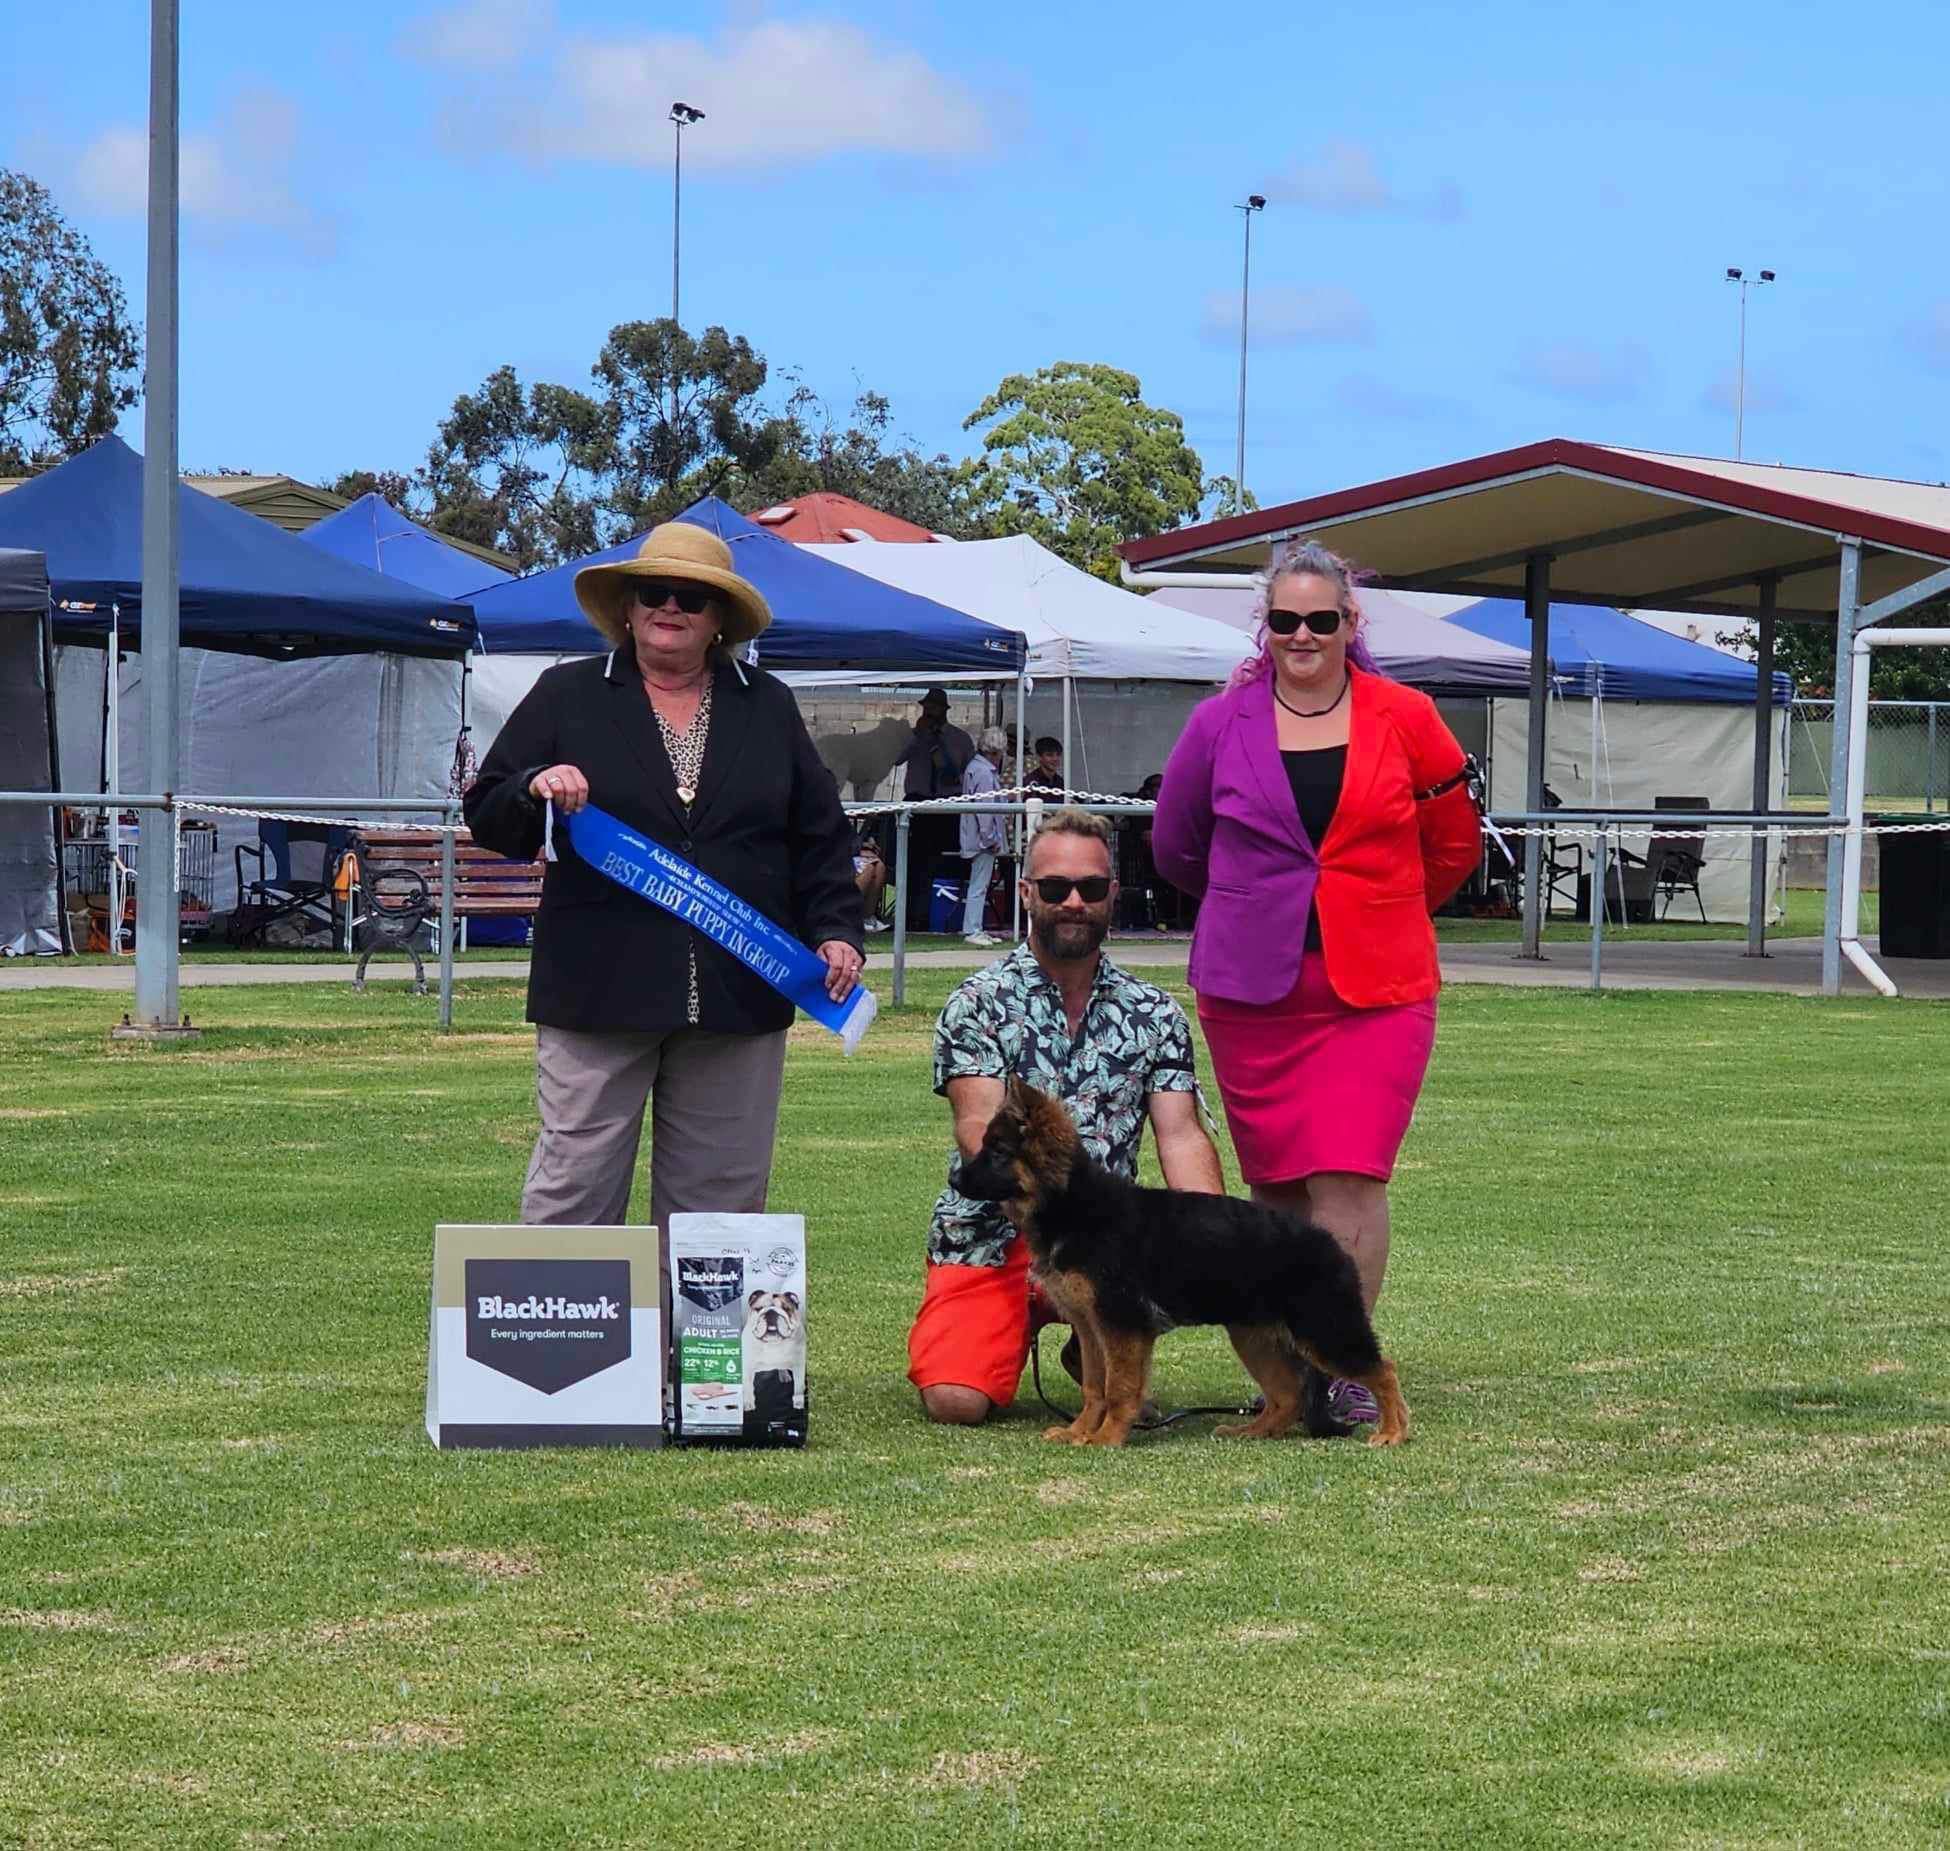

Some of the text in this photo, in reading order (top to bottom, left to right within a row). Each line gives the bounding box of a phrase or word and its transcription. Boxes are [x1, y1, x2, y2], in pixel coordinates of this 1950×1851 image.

[648, 847, 692, 880] Adelaide
[693, 874, 729, 905] Kennel
[729, 899, 753, 921] Club
[600, 851, 791, 984] BEST BABY PUPPY IN GROUP
[682, 1270, 739, 1281] BlackHawk
[477, 1295, 620, 1320] BlackHawk
[691, 1314, 731, 1326] ORIGINAL
[490, 1328, 604, 1341] Every ingredient matters
[683, 1327, 717, 1339] ADULT
[683, 1346, 716, 1355] CHICKEN
